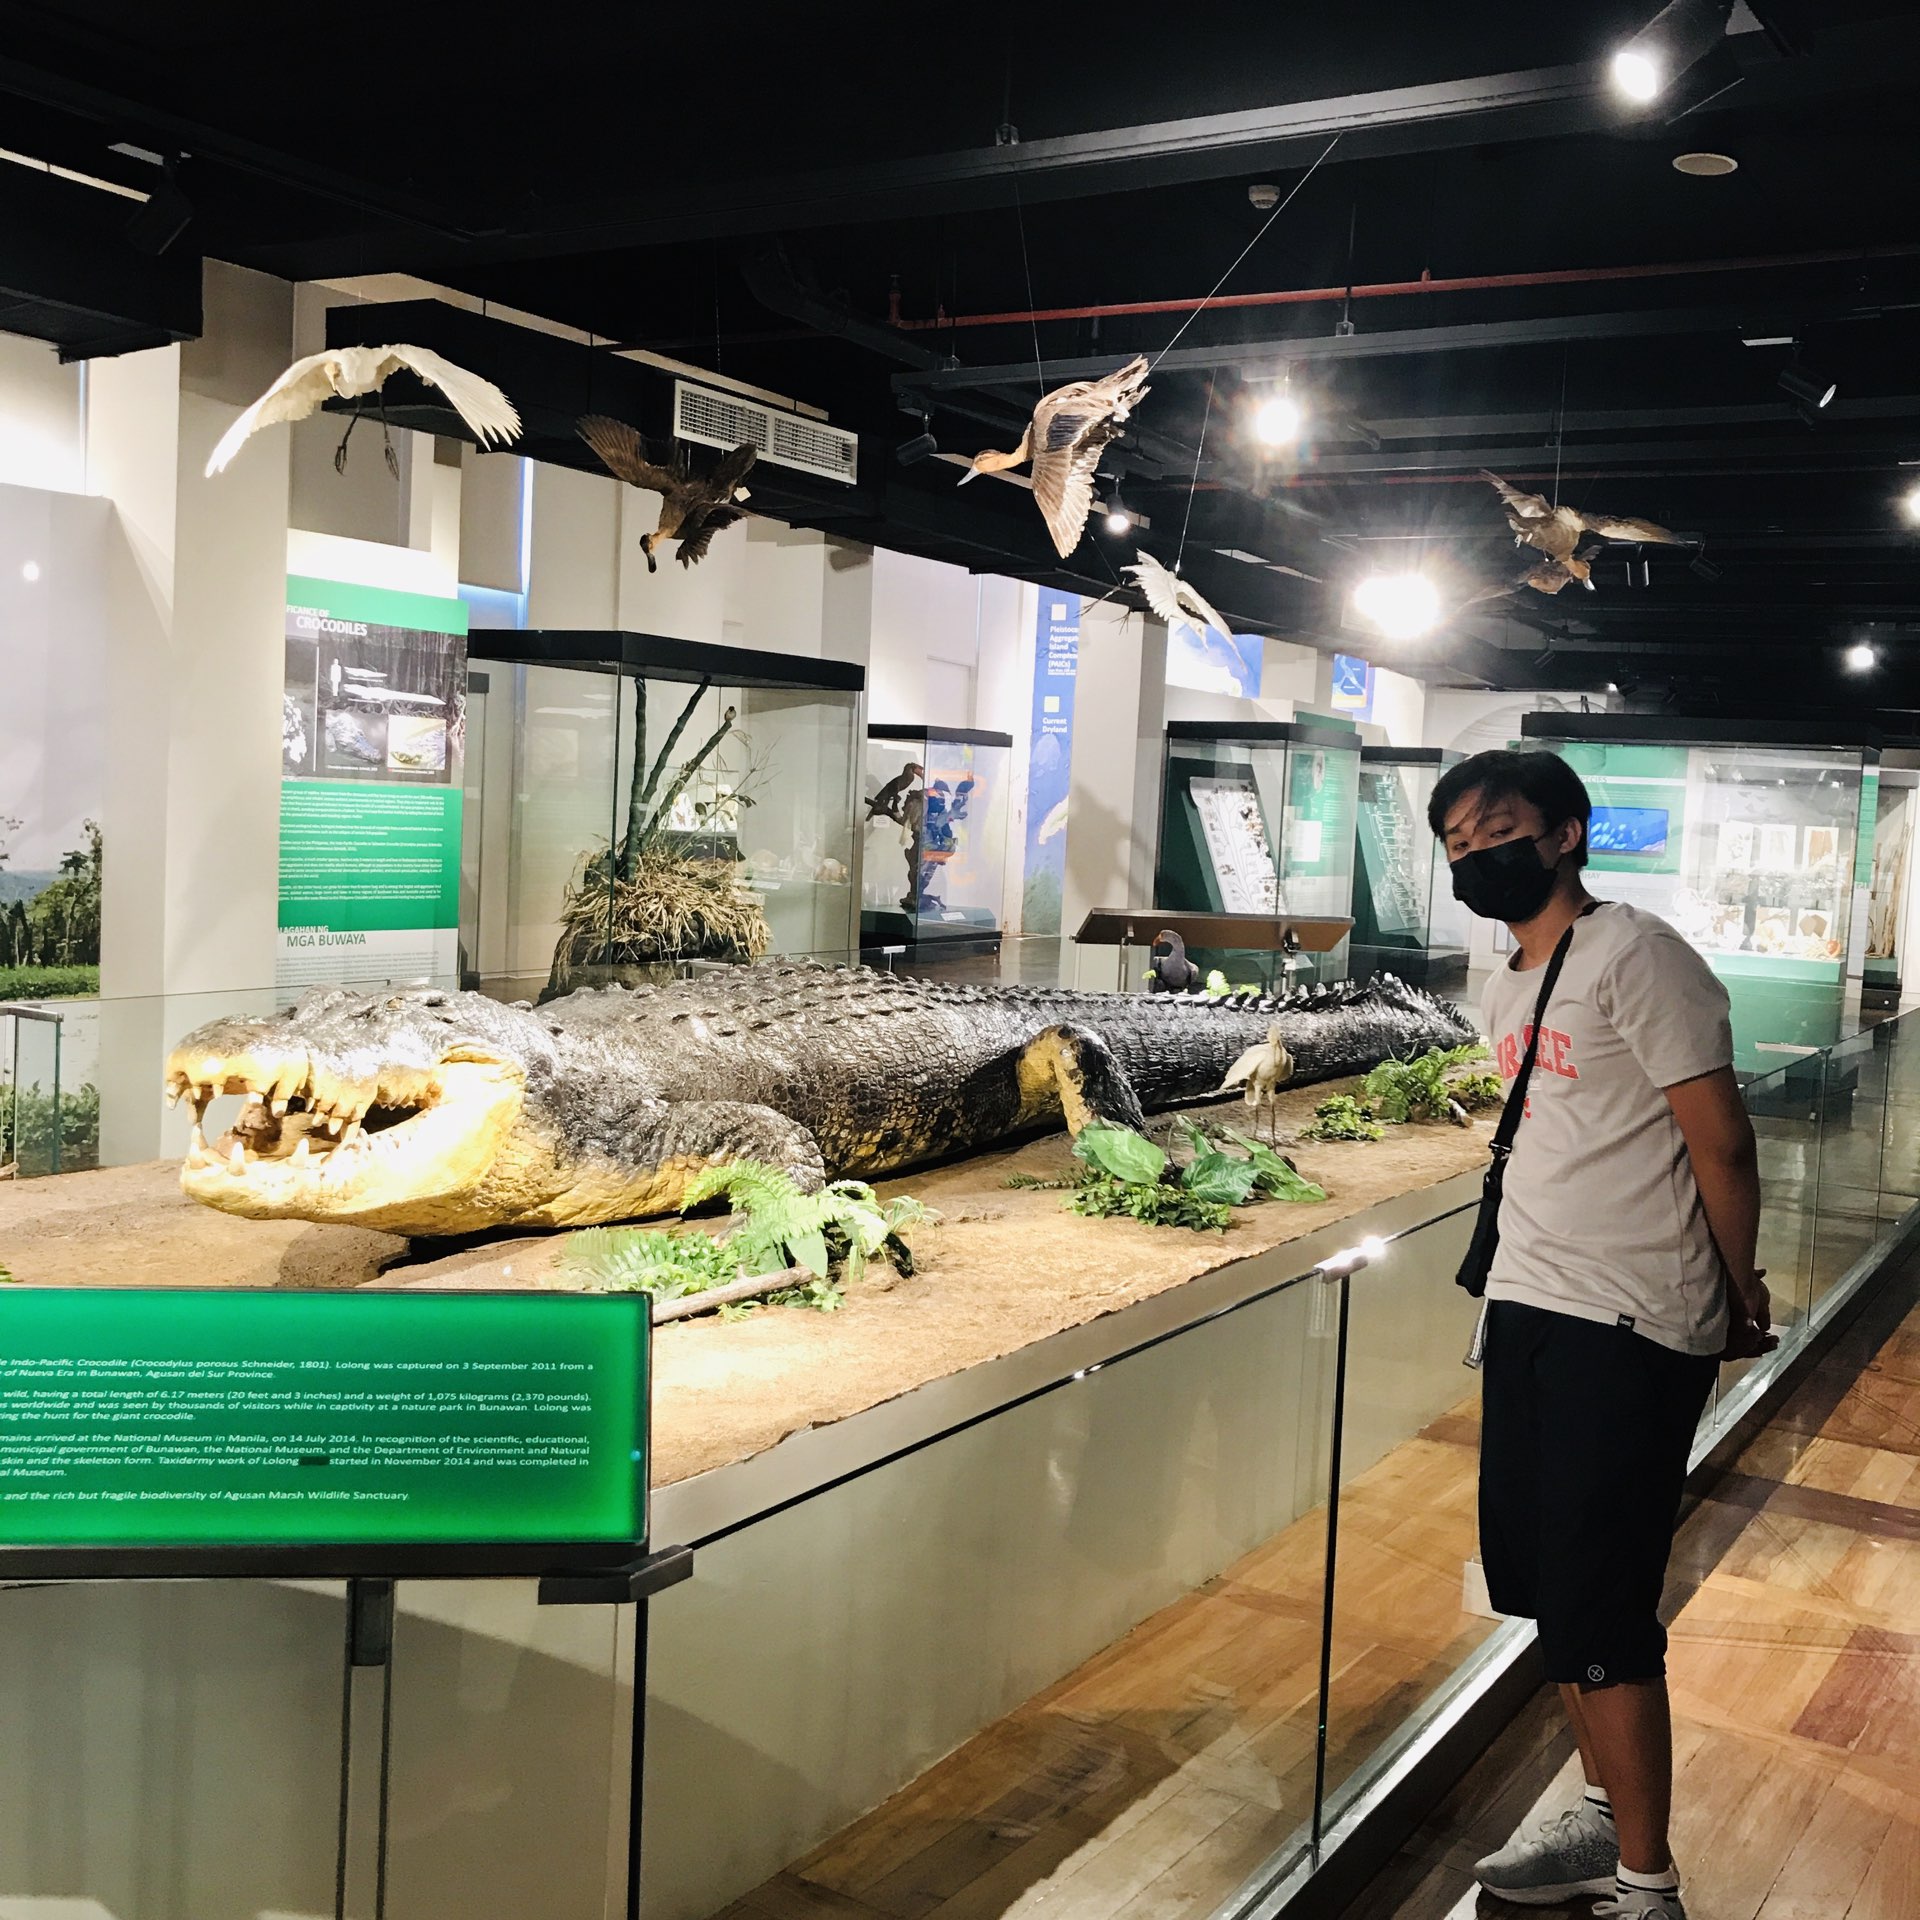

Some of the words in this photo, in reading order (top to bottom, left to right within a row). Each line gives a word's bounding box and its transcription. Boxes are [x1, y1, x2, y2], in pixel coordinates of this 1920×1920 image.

[319, 609, 330, 617] OF
[296, 616, 368, 636] CROCODILES
[1042, 726, 1067, 734] Dryland
[287, 935, 315, 947] MGA
[319, 933, 366, 946] BUWAYA
[10, 1358, 74, 1366] Indo-Pacific
[76, 1358, 128, 1366] Crocodile
[130, 1359, 193, 1369] (Crocodylus
[196, 1361, 239, 1369] porosus
[240, 1360, 295, 1369] Schneider,
[335, 1360, 371, 1370] Lolong
[396, 1361, 443, 1371] captured
[471, 1362, 528, 1372] September
[531, 1362, 557, 1370] 2011
[558, 1362, 585, 1370] from
[4, 1368, 16, 1376] of
[76, 1369, 87, 1377] in
[89, 1369, 142, 1378] Bunawan,
[146, 1370, 185, 1379] Agusan
[187, 1369, 204, 1377] del
[207, 1370, 224, 1378] Sur
[3, 1389, 30, 1398] wild,
[32, 1389, 70, 1399] having
[81, 1390, 107, 1398] total
[108, 1390, 144, 1400] length
[146, 1390, 158, 1398] of
[187, 1391, 225, 1399] meters
[227, 1391, 245, 1400] (20
[246, 1391, 269, 1399] feet
[271, 1391, 292, 1399] and
[303, 1391, 341, 1401] inches)
[344, 1391, 364, 1400] and
[375, 1392, 411, 1402] weight
[413, 1392, 424, 1400] of
[428, 1393, 456, 1401] 1,075
[458, 1392, 509, 1402] kilograms
[511, 1393, 544, 1402] (2,370
[11, 1400, 70, 1408] worldwide
[73, 1400, 95, 1408] and
[151, 1401, 165, 1411] by
[167, 1401, 225, 1409] thousands
[227, 1401, 239, 1409] of
[241, 1402, 281, 1410] visitors
[283, 1402, 313, 1410] while
[316, 1402, 326, 1410] in
[329, 1403, 374, 1412] captivity
[401, 1403, 436, 1411] nature
[439, 1403, 463, 1413] park
[465, 1403, 476, 1411] in
[533, 1403, 569, 1414] Lolong
[21, 1411, 40, 1419] the
[42, 1411, 70, 1419] hunt
[72, 1411, 88, 1419] for
[91, 1411, 110, 1419] the
[112, 1412, 140, 1421] giant
[34, 1433, 75, 1441] arrived
[91, 1433, 111, 1441] the
[113, 1433, 160, 1442] National
[163, 1434, 212, 1442] Museum
[215, 1434, 225, 1442] in
[228, 1434, 268, 1443] Manila,
[306, 1434, 326, 1444] July
[361, 1435, 372, 1443] In
[375, 1435, 436, 1445] recognition
[438, 1435, 449, 1443] of
[452, 1435, 470, 1443] the
[473, 1435, 522, 1444] scientific,
[525, 1435, 589, 1445] educational,
[0, 1445, 57, 1455] municipal
[58, 1446, 128, 1455] government
[130, 1445, 142, 1453] of
[145, 1445, 200, 1454] Bunawan,
[203, 1445, 222, 1453] the
[224, 1445, 272, 1453] National
[274, 1446, 326, 1455] Museum,
[329, 1445, 350, 1454] and
[352, 1446, 371, 1454] the
[373, 1446, 440, 1456] Department
[442, 1446, 454, 1454] of
[527, 1446, 548, 1454] and
[549, 1446, 590, 1455] Natural
[0, 1456, 24, 1464] skin
[26, 1456, 49, 1464] and
[50, 1456, 71, 1464] the
[73, 1456, 121, 1464] skeleton
[158, 1456, 215, 1466] Taxidermy
[216, 1456, 246, 1464] work
[247, 1456, 260, 1464] of
[262, 1456, 300, 1467] Lolong
[328, 1457, 369, 1465] started
[370, 1457, 382, 1465] in
[383, 1457, 440, 1465] November
[443, 1457, 471, 1465] 2014
[473, 1457, 494, 1465] and
[519, 1457, 577, 1467] completed
[578, 1458, 589, 1466] in
[11, 1468, 67, 1476] Museum.
[4, 1491, 28, 1499] and
[29, 1491, 50, 1499] the
[52, 1491, 75, 1499] rich
[77, 1491, 98, 1499] but
[100, 1491, 137, 1501] fragile
[139, 1491, 206, 1501] biodiversity
[209, 1491, 221, 1499] of
[224, 1491, 266, 1501] Agusan
[268, 1491, 304, 1499] Marsh
[306, 1491, 350, 1499] Wildlife
